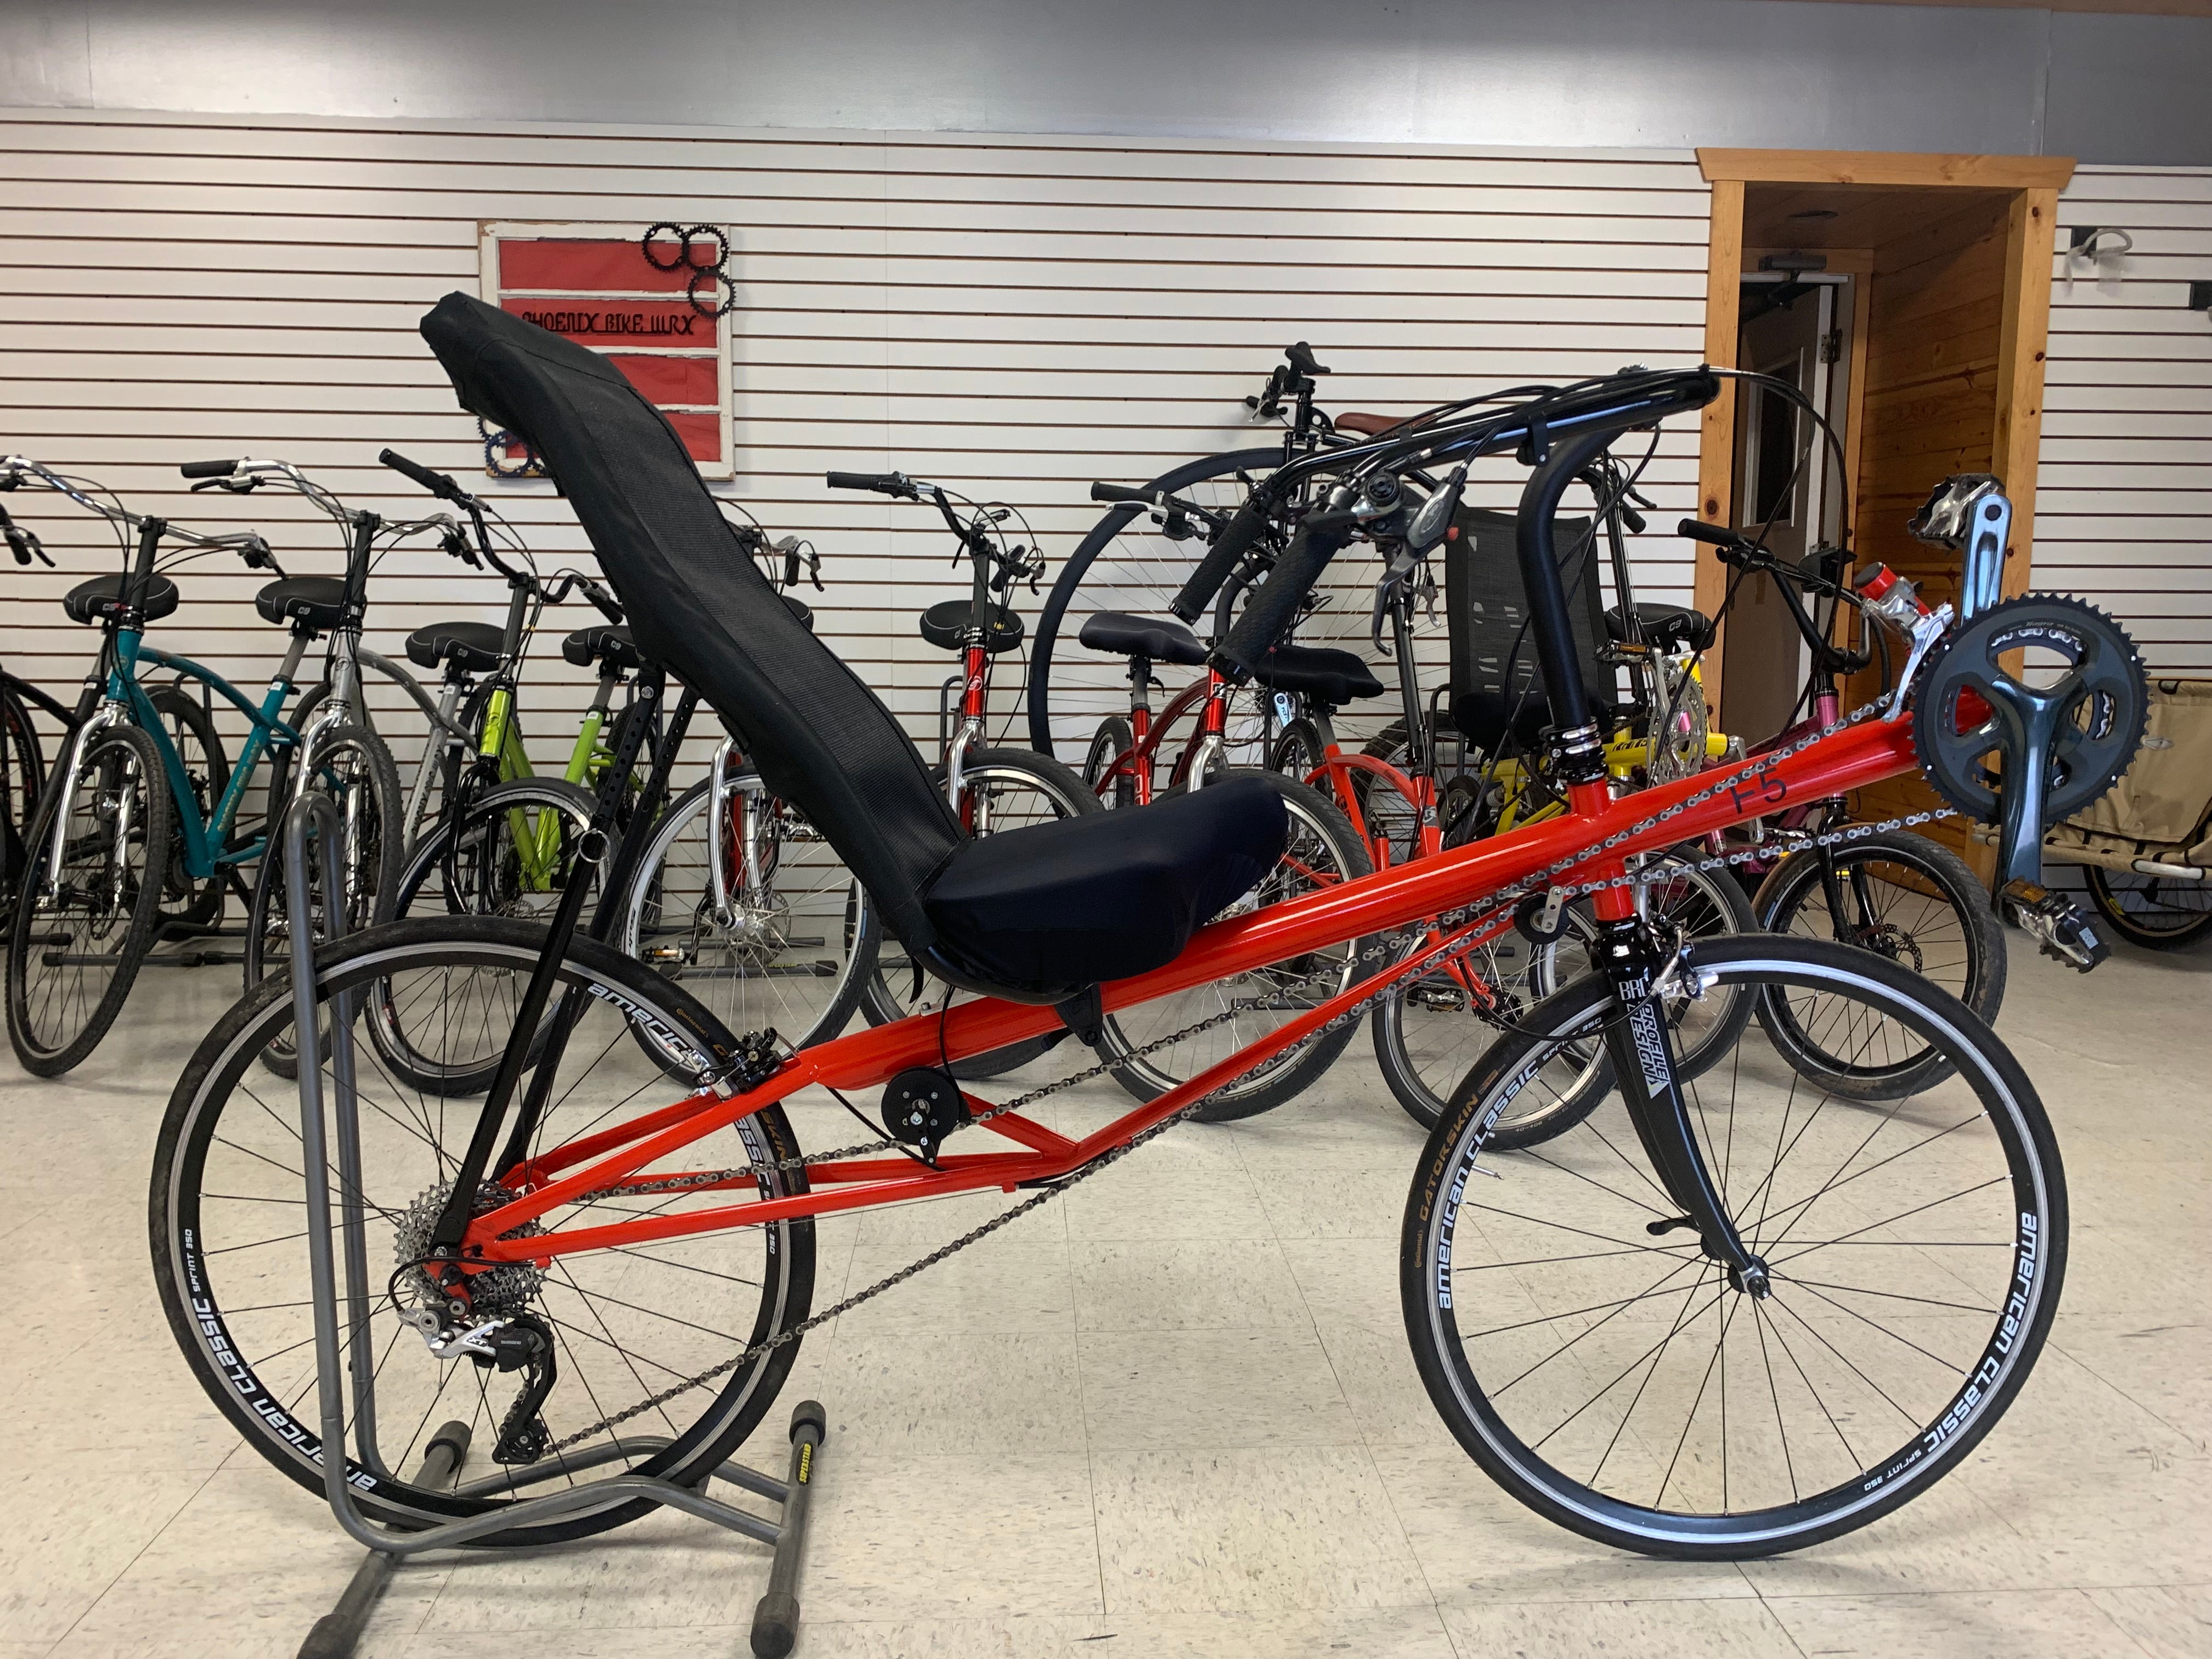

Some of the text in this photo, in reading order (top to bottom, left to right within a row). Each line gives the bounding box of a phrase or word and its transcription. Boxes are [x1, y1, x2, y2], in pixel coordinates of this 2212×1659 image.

[605, 312, 643, 334] BIKE
[651, 314, 697, 335] WRX
[1669, 619, 1682, 632] C9
[1729, 766, 1787, 815] F5
[1582, 1017, 1602, 1032] 350
[1640, 1003, 1670, 1081] PROFILE
[1414, 1093, 1479, 1268] Continental GATORSKIN
[185, 1229, 194, 1249] 350
[467, 1337, 487, 1345] XT
[799, 1443, 812, 1483] SUPERSTAND
[1864, 1476, 1883, 1491] 350
